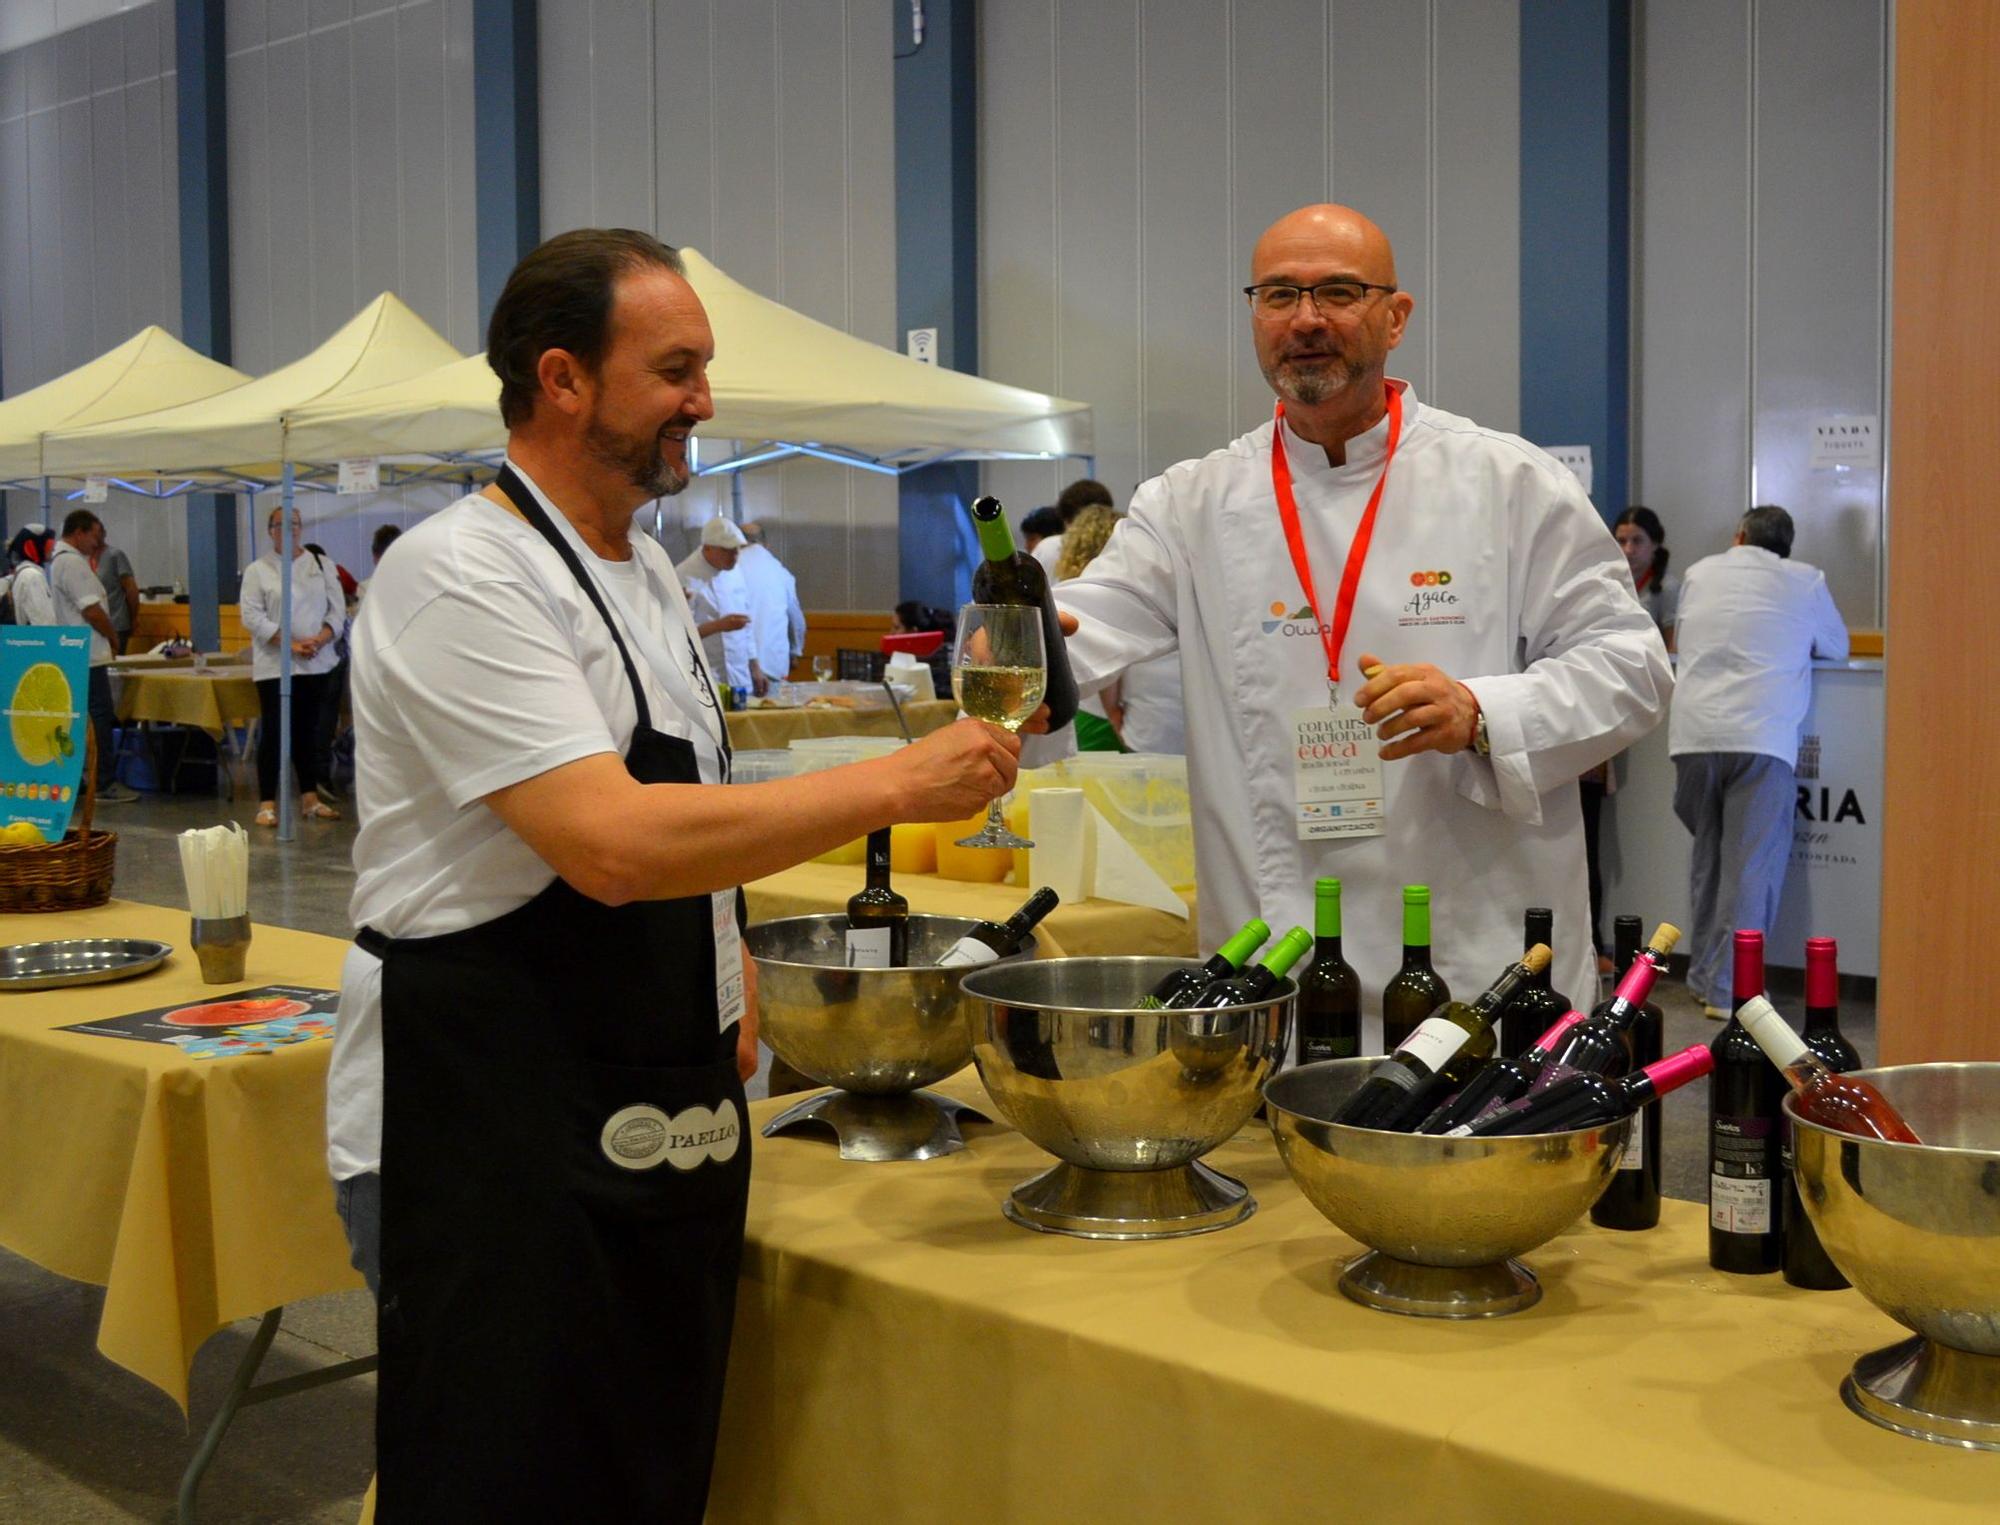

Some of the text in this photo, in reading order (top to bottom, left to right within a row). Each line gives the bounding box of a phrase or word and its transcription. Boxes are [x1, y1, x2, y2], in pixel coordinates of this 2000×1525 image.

[1299, 728, 1372, 745] nacional
[1796, 785, 1866, 825] RIA
[669, 1123, 737, 1149] PAELLO
